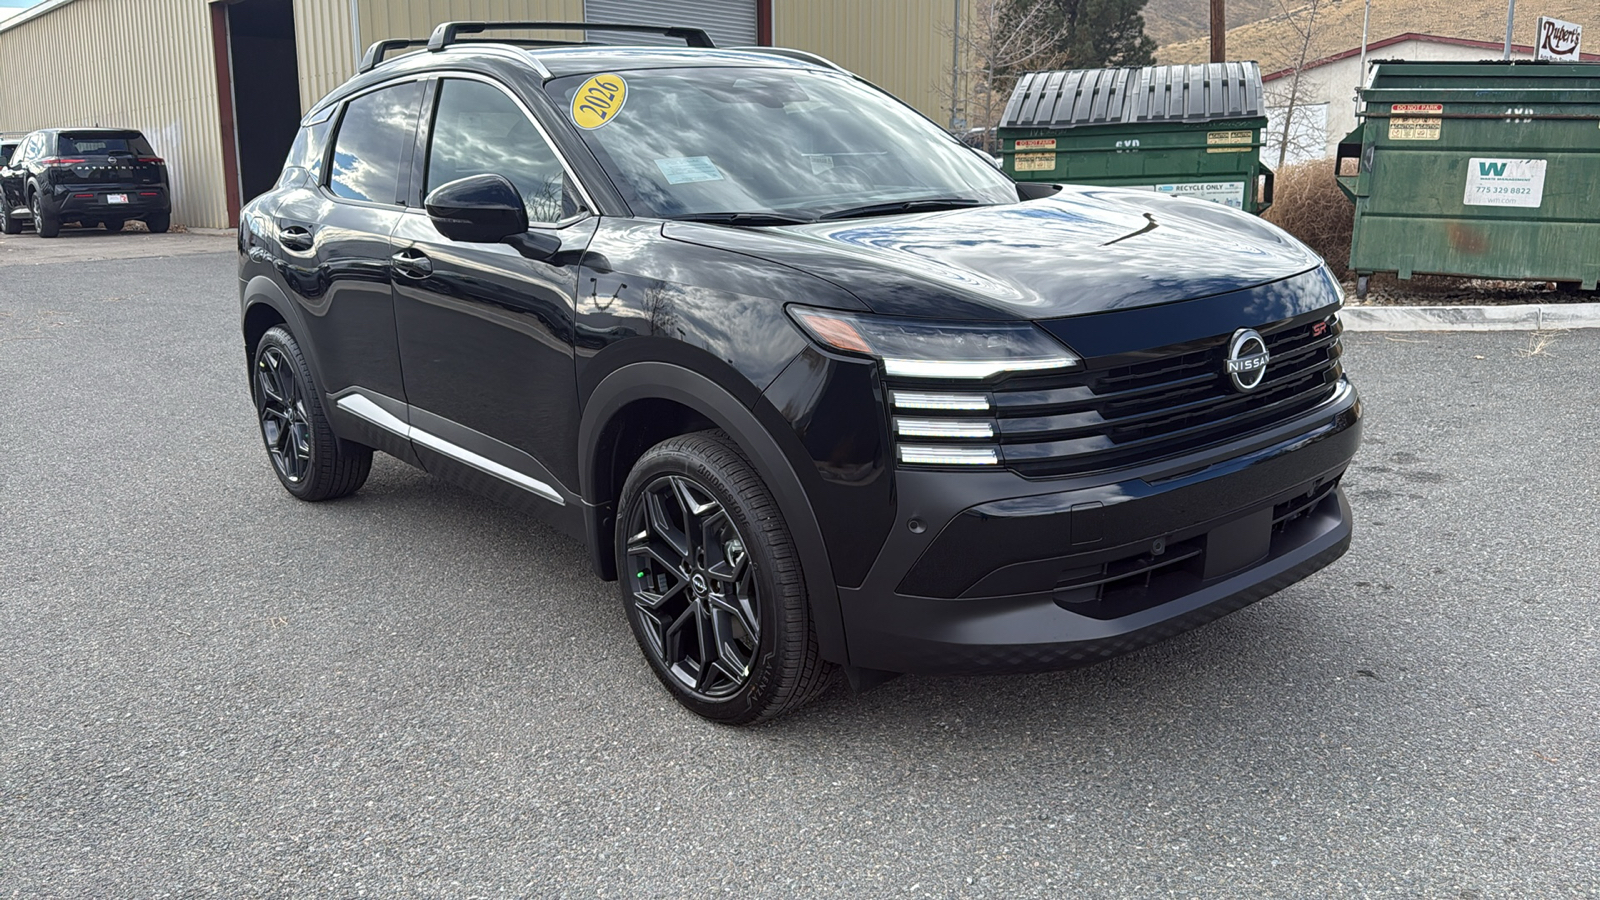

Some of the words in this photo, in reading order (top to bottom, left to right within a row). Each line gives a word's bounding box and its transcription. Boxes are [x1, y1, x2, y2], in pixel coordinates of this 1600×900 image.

[1541, 20, 1580, 55] Rupert's
[579, 78, 619, 120] 2026
[1175, 184, 1205, 192] RECYCLE
[1205, 183, 1224, 191] ONLY
[1312, 321, 1327, 337] SR
[1229, 352, 1270, 372] NISSAN
[697, 463, 751, 529] BRIDGESTONE
